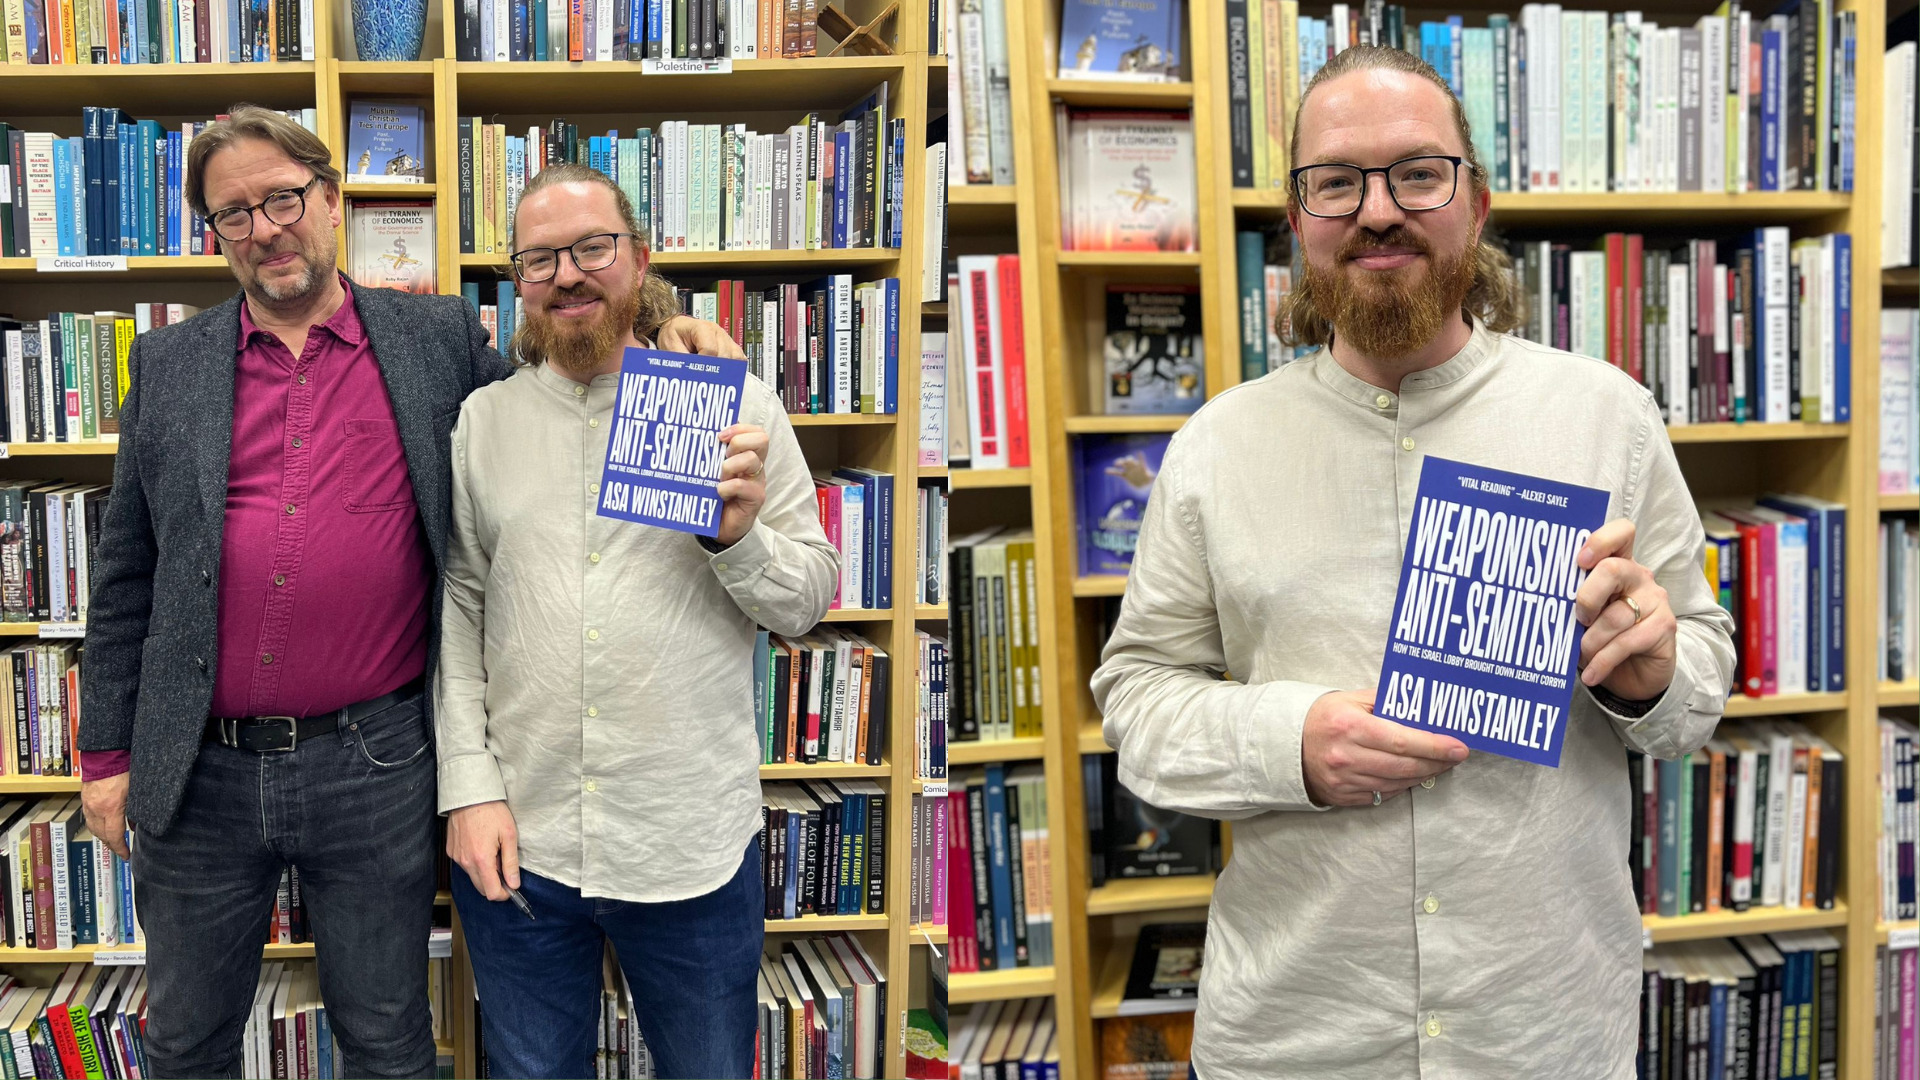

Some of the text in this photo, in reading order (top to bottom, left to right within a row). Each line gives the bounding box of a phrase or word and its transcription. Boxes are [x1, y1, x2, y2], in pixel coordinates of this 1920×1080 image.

[64, 5, 74, 48] Fatima Manji
[656, 61, 702, 73] Palestine
[1230, 17, 1247, 100] ENCLOSURE
[368, 114, 400, 123] Christian
[383, 123, 409, 131] Europe
[710, 129, 718, 176] ENFORCING
[867, 137, 873, 147] 51
[461, 138, 470, 193] ENCLOSURE
[73, 165, 82, 234] IMPERIAL NOSTALGIA
[710, 178, 718, 210] SILENCE
[781, 180, 787, 189] TO
[86, 260, 114, 268] History
[81, 334, 93, 425] The Coolie's Great War
[101, 325, 113, 418] PRINCES COTTON
[705, 364, 720, 373] SAYLE
[619, 372, 737, 431] WEAPONISING
[609, 417, 727, 479] ANTI-SEMITISM
[627, 467, 640, 475] ISRAEL
[641, 469, 654, 477] LOBBY
[654, 471, 674, 481] BROUGHT
[674, 474, 686, 483] DOWN
[687, 476, 703, 486] JEREMY
[704, 479, 720, 487] CORBY
[602, 481, 717, 528] ASA WINSTANLEY
[1546, 494, 1568, 508] SAYLE
[850, 558, 858, 585] Pakistan
[1395, 568, 1577, 676] ANTI-SEMITISM
[1392, 642, 1567, 689] HOW THE ISRAEL LOBBY BROUGHT DOWN JEREMY CORBYN
[833, 679, 845, 731] HIZB UT-TAHRIR
[850, 684, 859, 717] TURKEY
[1381, 670, 1560, 752] ASA WINSTANLEY
[31, 713, 37, 722] OF
[924, 804, 932, 827] NADIYA
[936, 803, 944, 832] Nadiya's
[842, 846, 850, 857] NEW
[854, 845, 862, 857] NEW
[855, 834, 863, 844] THE
[806, 826, 817, 897] AGE OF FOLLY
[841, 859, 849, 886] CRUSADES
[852, 858, 861, 885] CRUSADES
[55, 827, 68, 927] THE SWORD AND THE SHIELD
[69, 1009, 99, 1074] FAKE HISTORY
[276, 1049, 285, 1078] COOLIE
